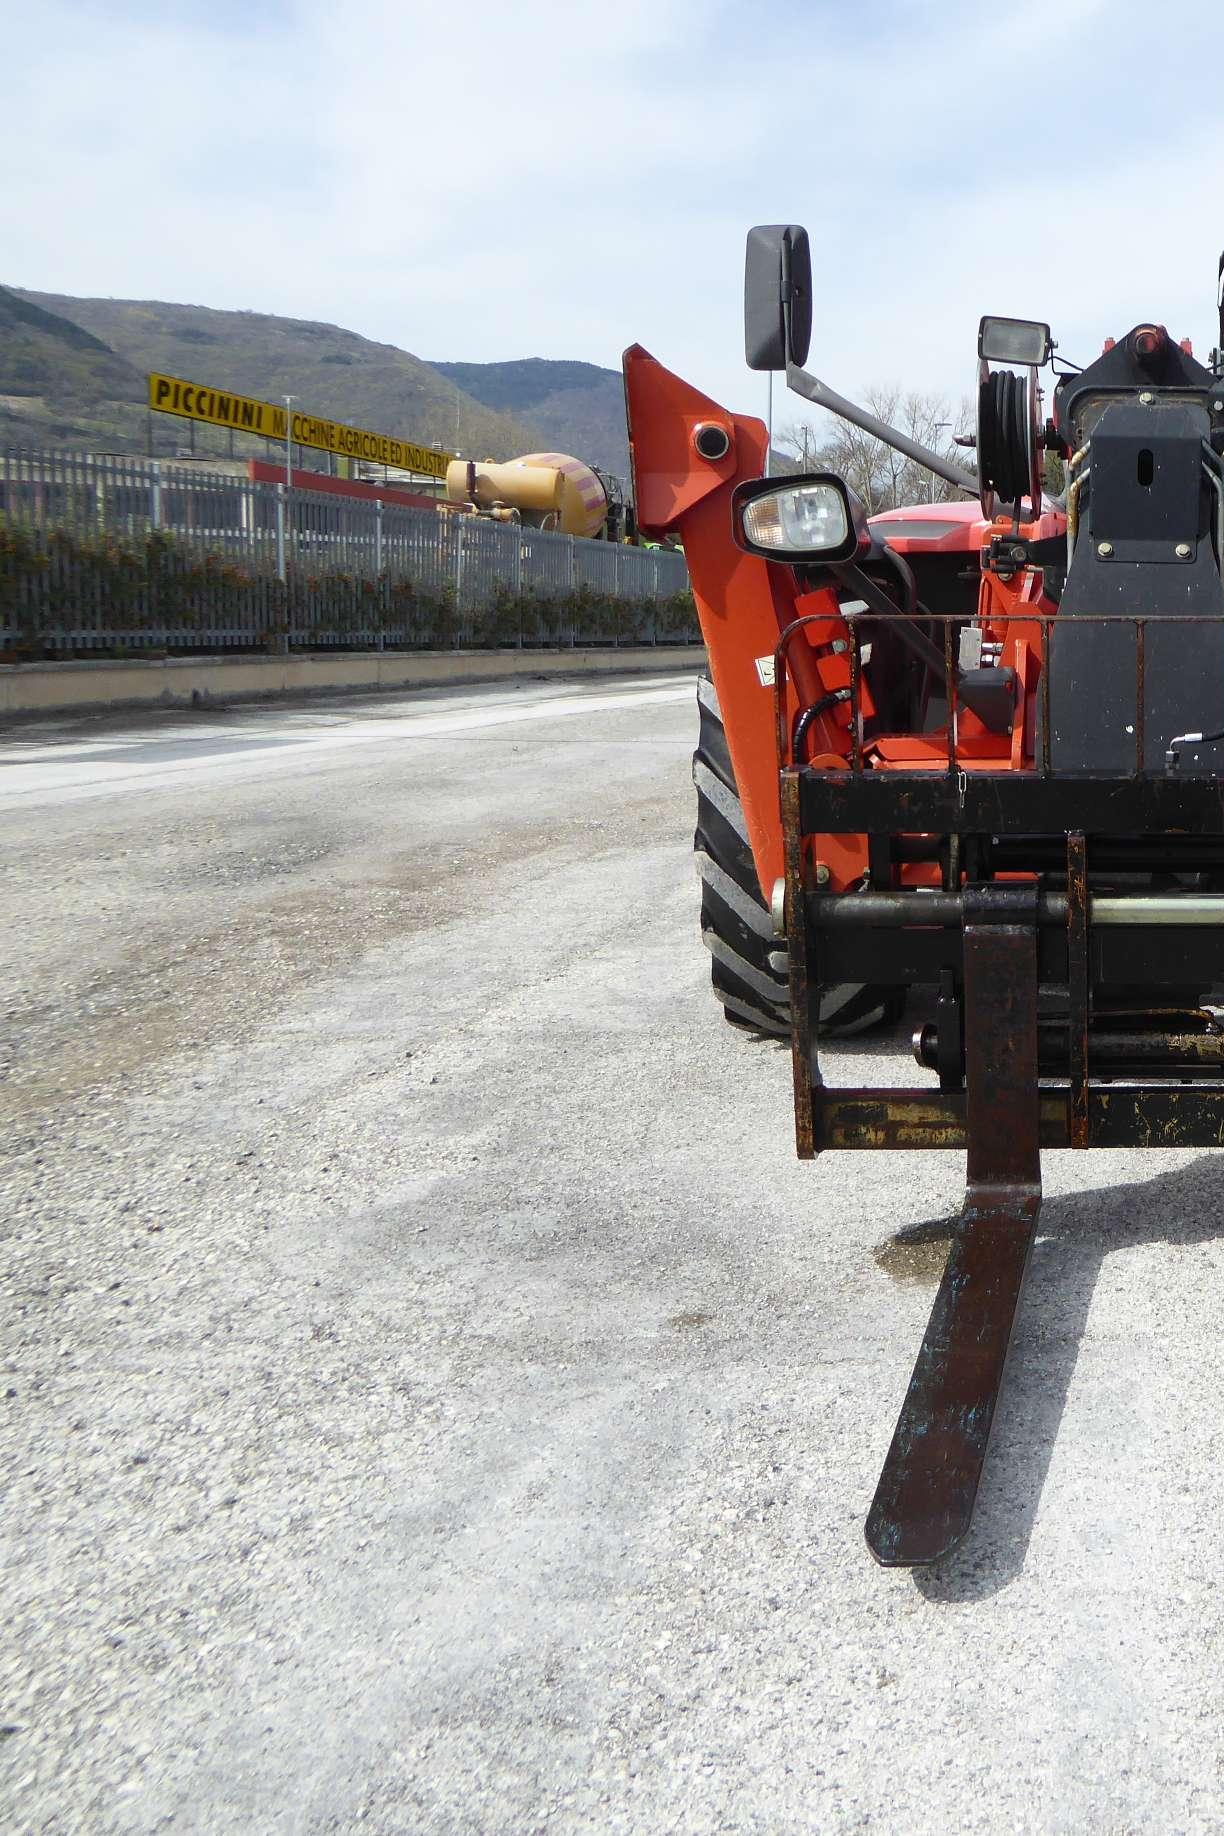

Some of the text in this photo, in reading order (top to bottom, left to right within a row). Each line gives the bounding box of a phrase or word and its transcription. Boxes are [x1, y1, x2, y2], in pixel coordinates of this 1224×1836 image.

[156, 379, 448, 475] PICCININI MACCHINE AGRICOLE ED INDUSTRI
